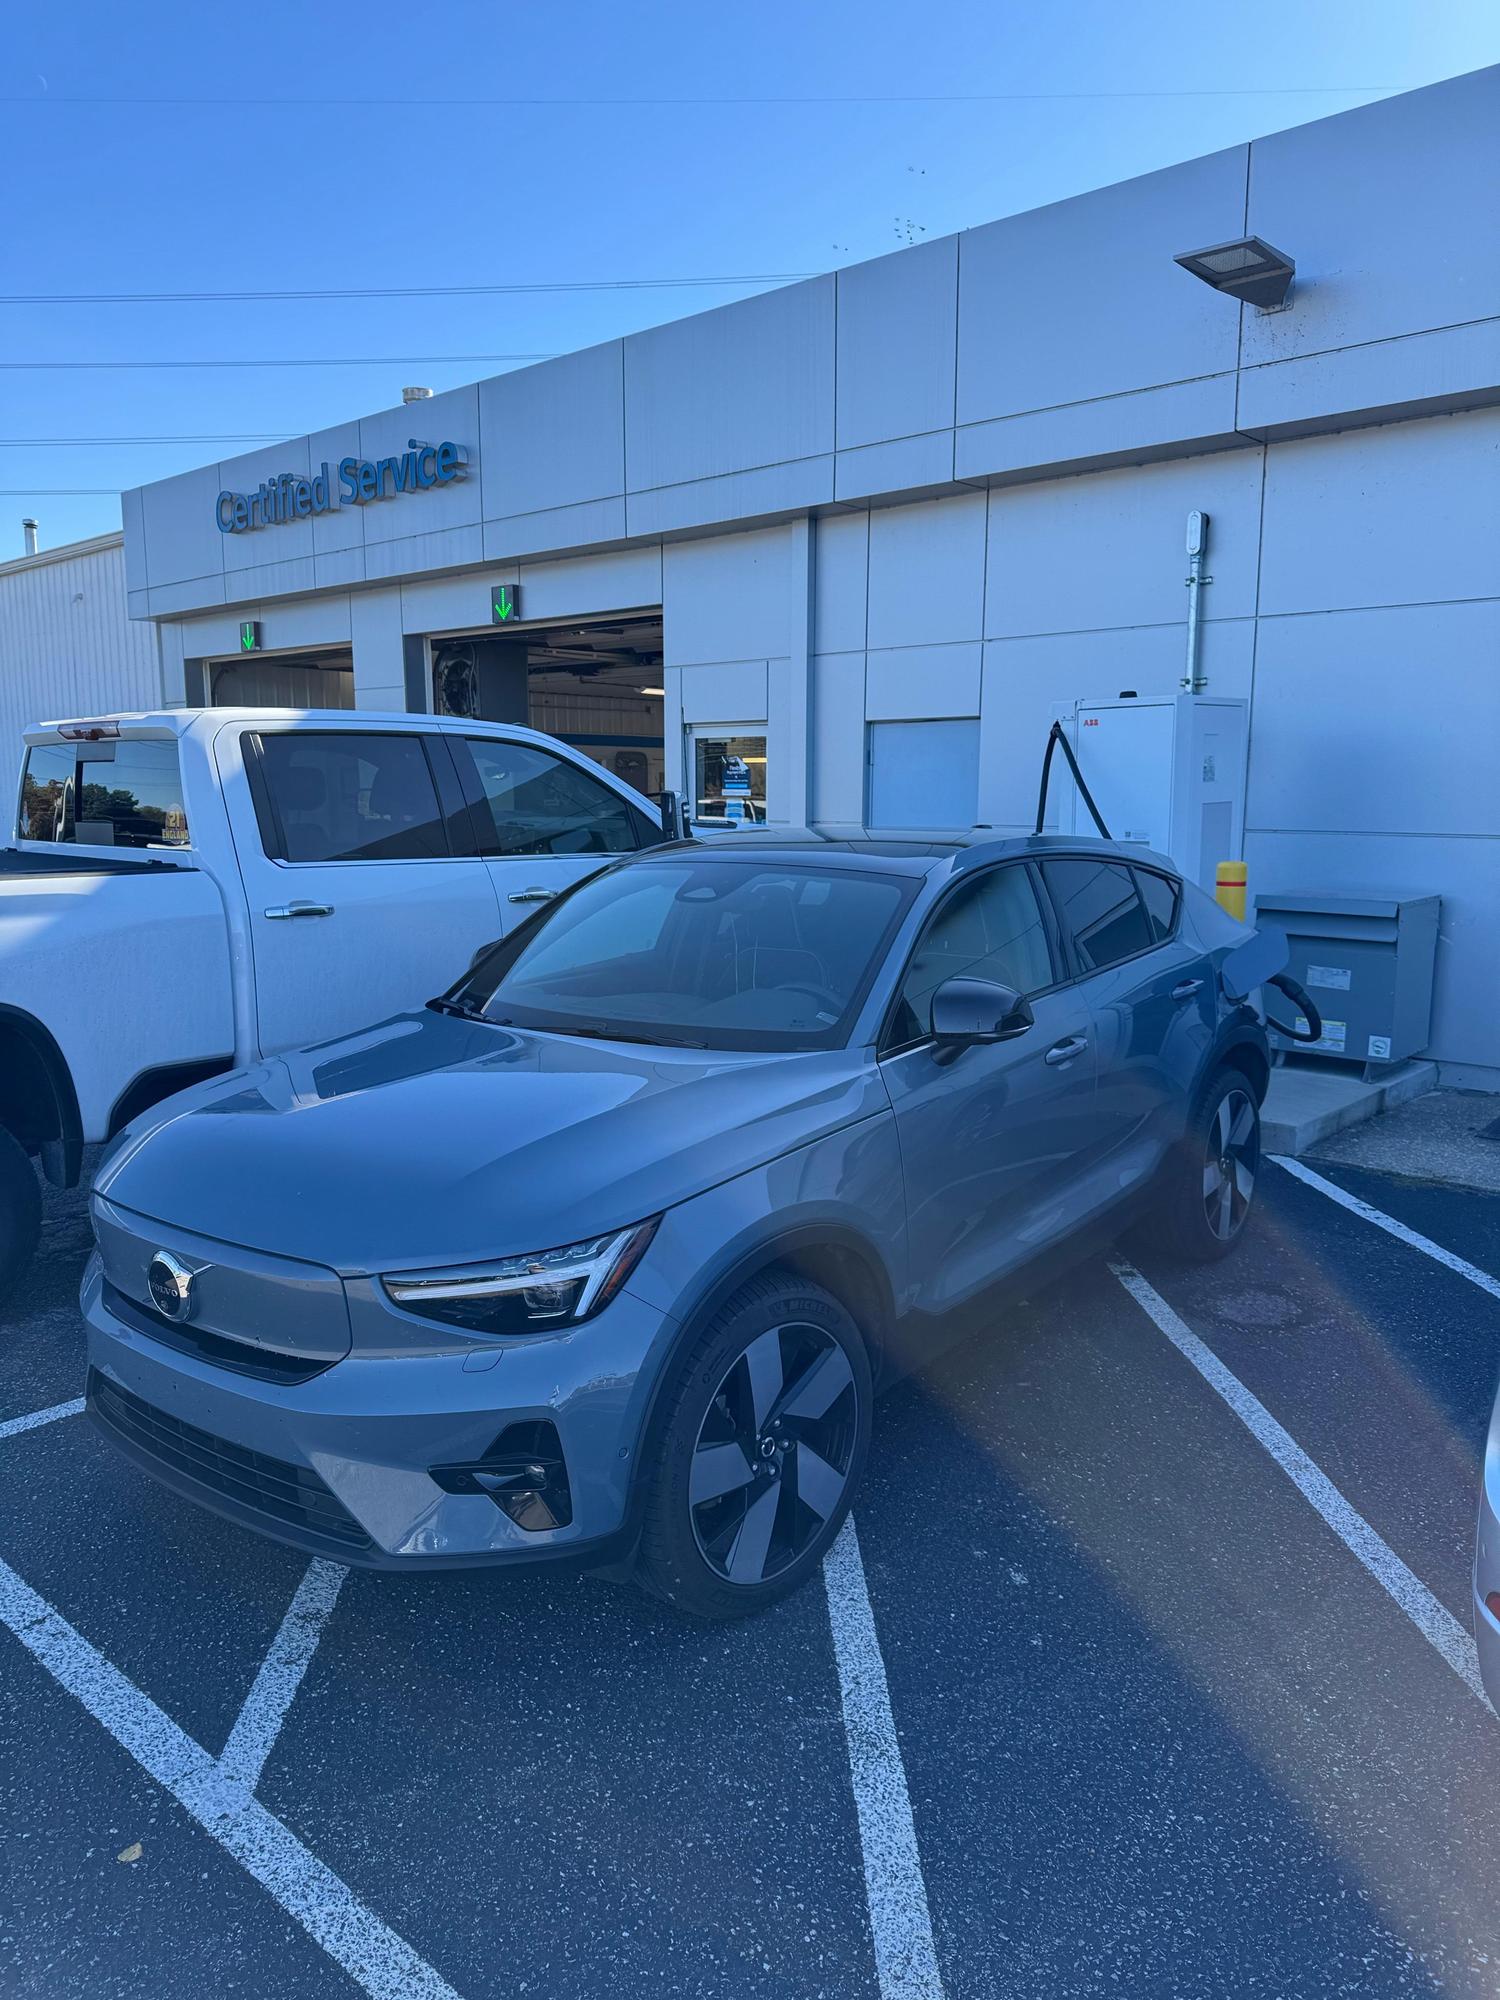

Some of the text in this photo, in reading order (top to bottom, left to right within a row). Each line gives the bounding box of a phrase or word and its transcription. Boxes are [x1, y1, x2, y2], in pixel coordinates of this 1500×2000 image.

[216, 438, 461, 533] Certified Service
[1083, 719, 1099, 727] ABB
[168, 811, 180, 827] 21
[152, 1281, 178, 1297] VOLVO
